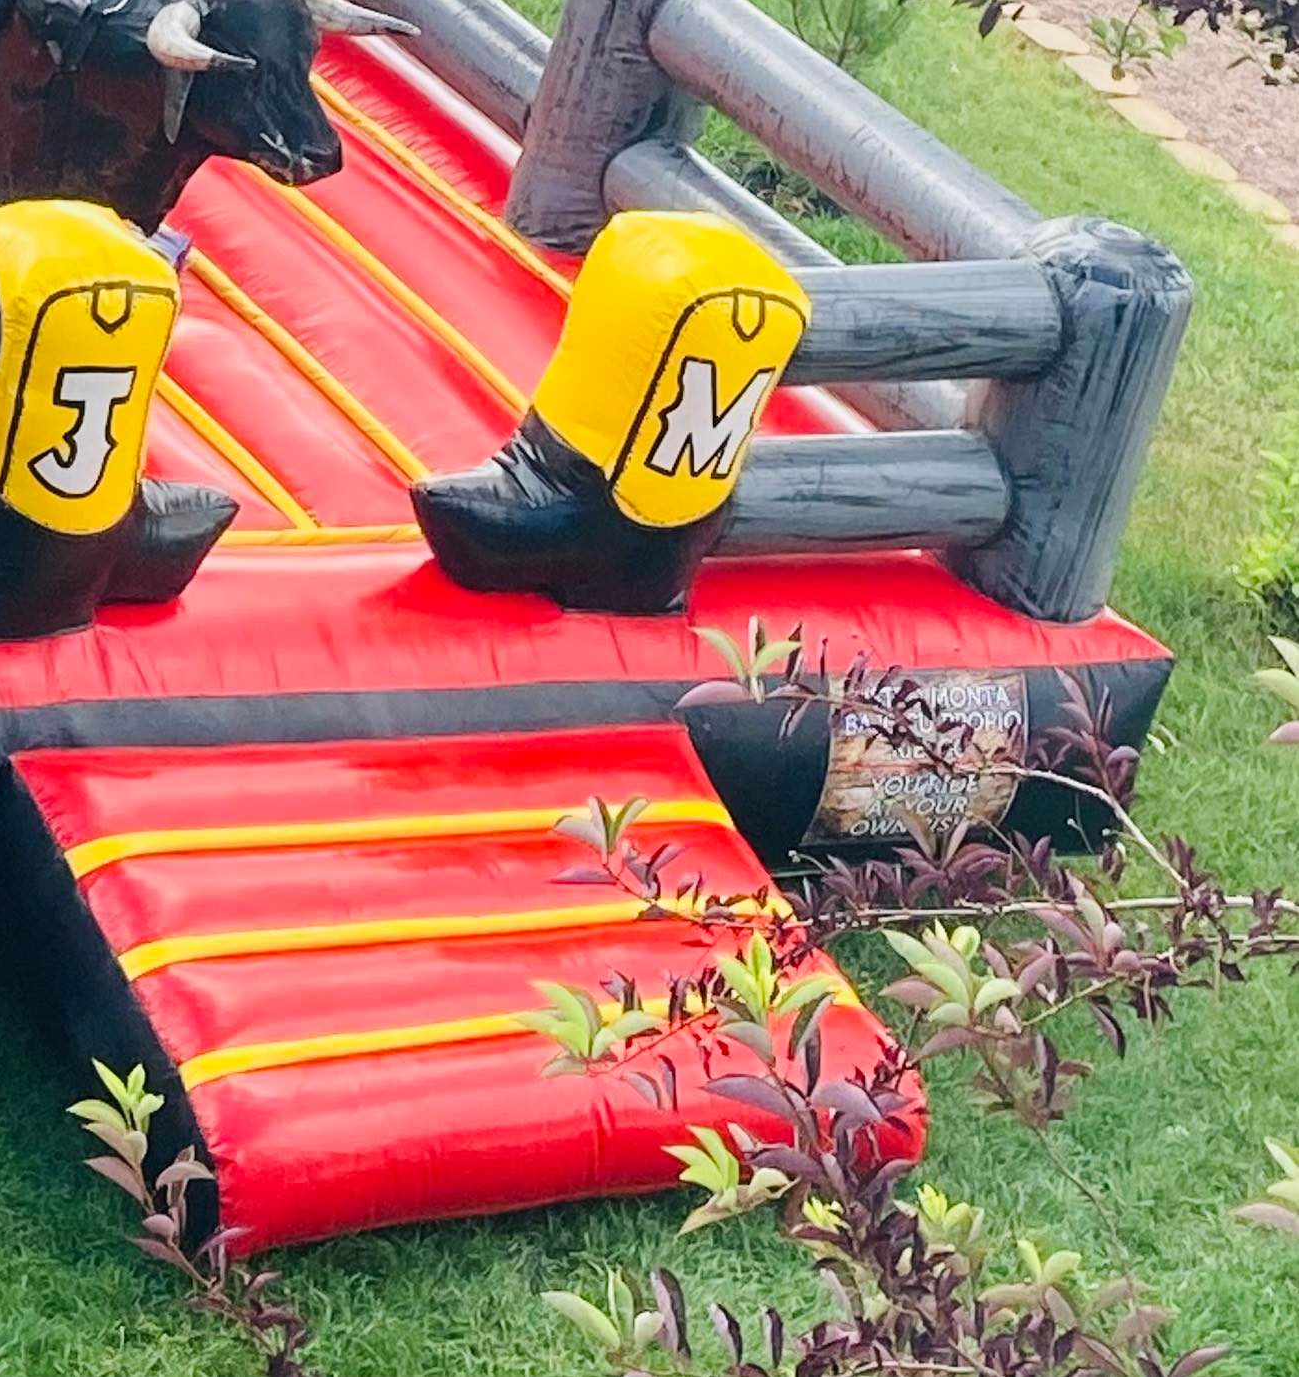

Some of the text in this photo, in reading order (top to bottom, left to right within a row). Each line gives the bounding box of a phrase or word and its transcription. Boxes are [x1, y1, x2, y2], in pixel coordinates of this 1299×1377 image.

[27, 365, 137, 499] J
[644, 355, 776, 480] M
[931, 685, 1011, 709] MONTA
